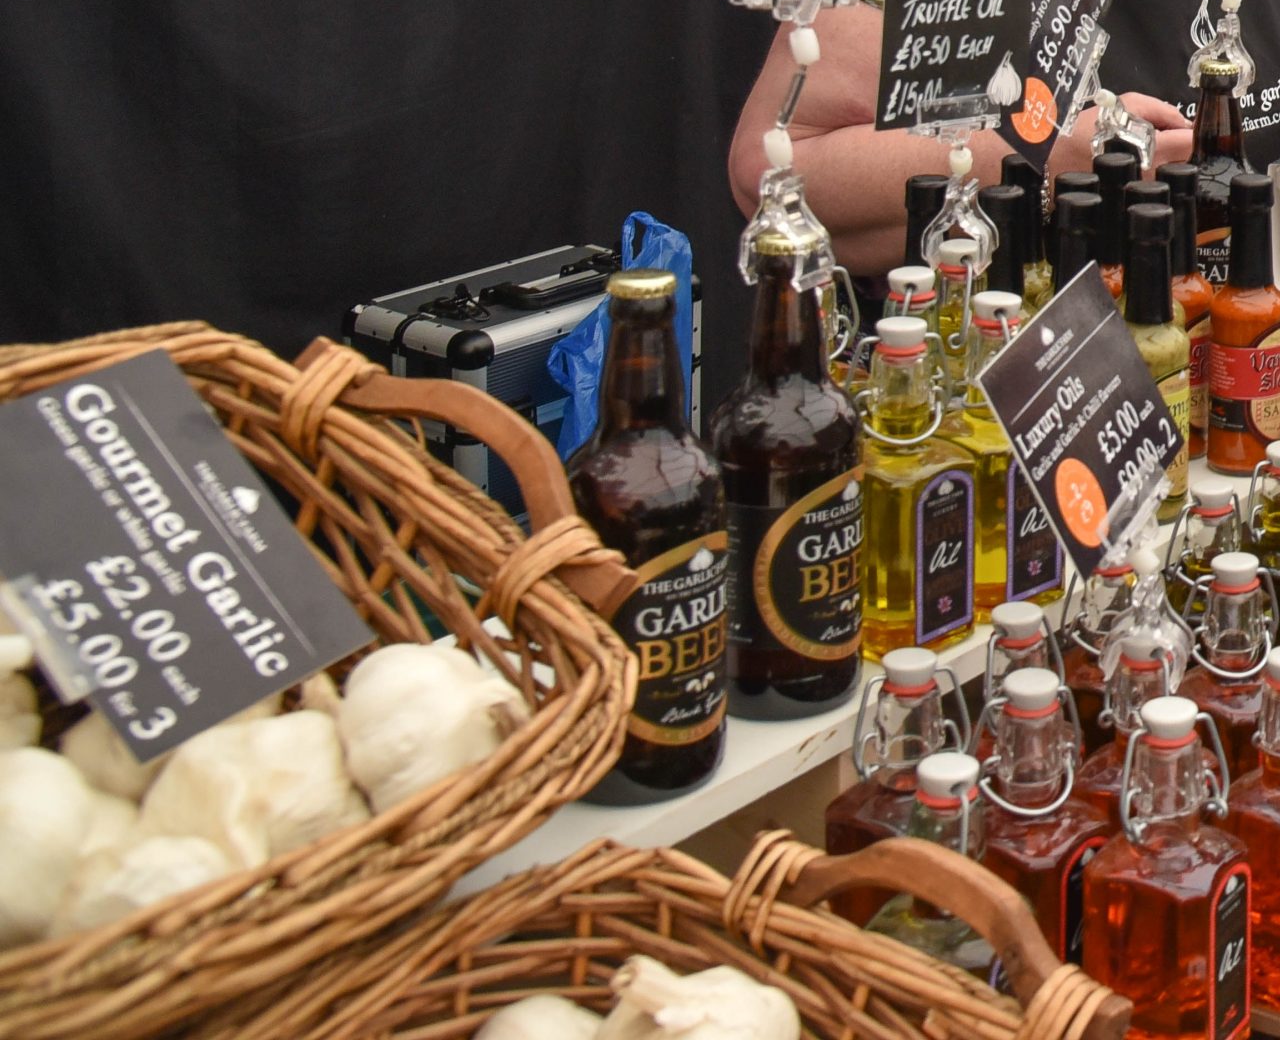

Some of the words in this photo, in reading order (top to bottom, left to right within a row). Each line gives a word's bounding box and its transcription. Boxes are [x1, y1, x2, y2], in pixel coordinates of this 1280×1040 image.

[957, 34, 994, 60] EACH
[1037, 5, 1072, 73] £6.90
[1056, 13, 1095, 92] £12.00
[1240, 92, 1255, 108] on
[1015, 401, 1063, 460] Luxury
[1056, 375, 1085, 411] Oils
[1097, 400, 1140, 464] £5.00
[1139, 399, 1155, 421] each
[1159, 417, 1177, 448] 2
[1031, 455, 1053, 482] Garlic
[1050, 439, 1064, 460] and
[1060, 422, 1080, 447] Garlic
[65, 384, 202, 554] Gourmet
[187, 551, 289, 678] Garlic
[804, 510, 829, 525] THE
[642, 581, 672, 596] THE
[798, 549, 862, 602] BEE
[85, 556, 191, 662] £2.00
[162, 665, 200, 706] each
[635, 580, 728, 637] GARLI
[33, 579, 139, 689] £5.00
[108, 690, 139, 718] for
[128, 706, 177, 741] 3
[636, 613, 727, 680] BEE
